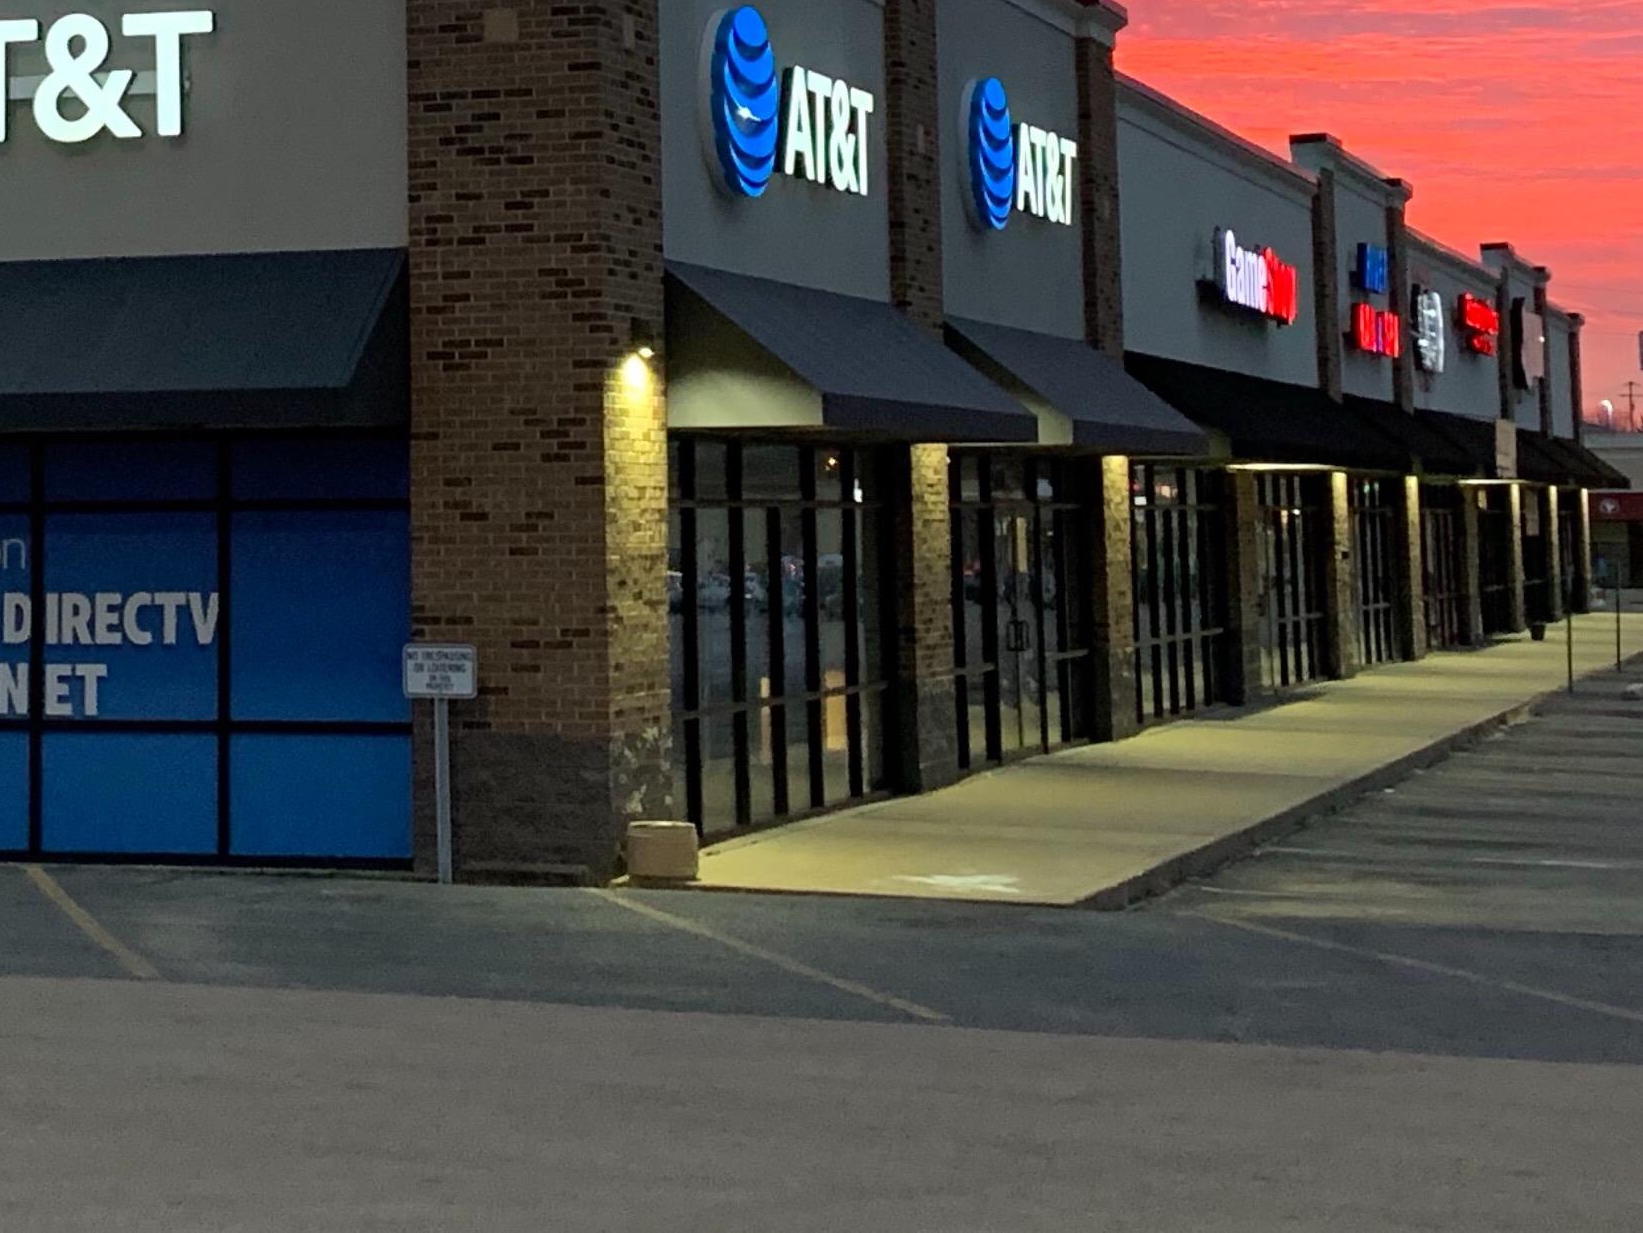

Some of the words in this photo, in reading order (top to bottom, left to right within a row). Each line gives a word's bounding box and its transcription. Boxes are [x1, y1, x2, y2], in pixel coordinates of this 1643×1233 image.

[783, 64, 874, 197] AT&T
[1016, 122, 1078, 226] AT&T
[3, 592, 219, 645] DIRECTV
